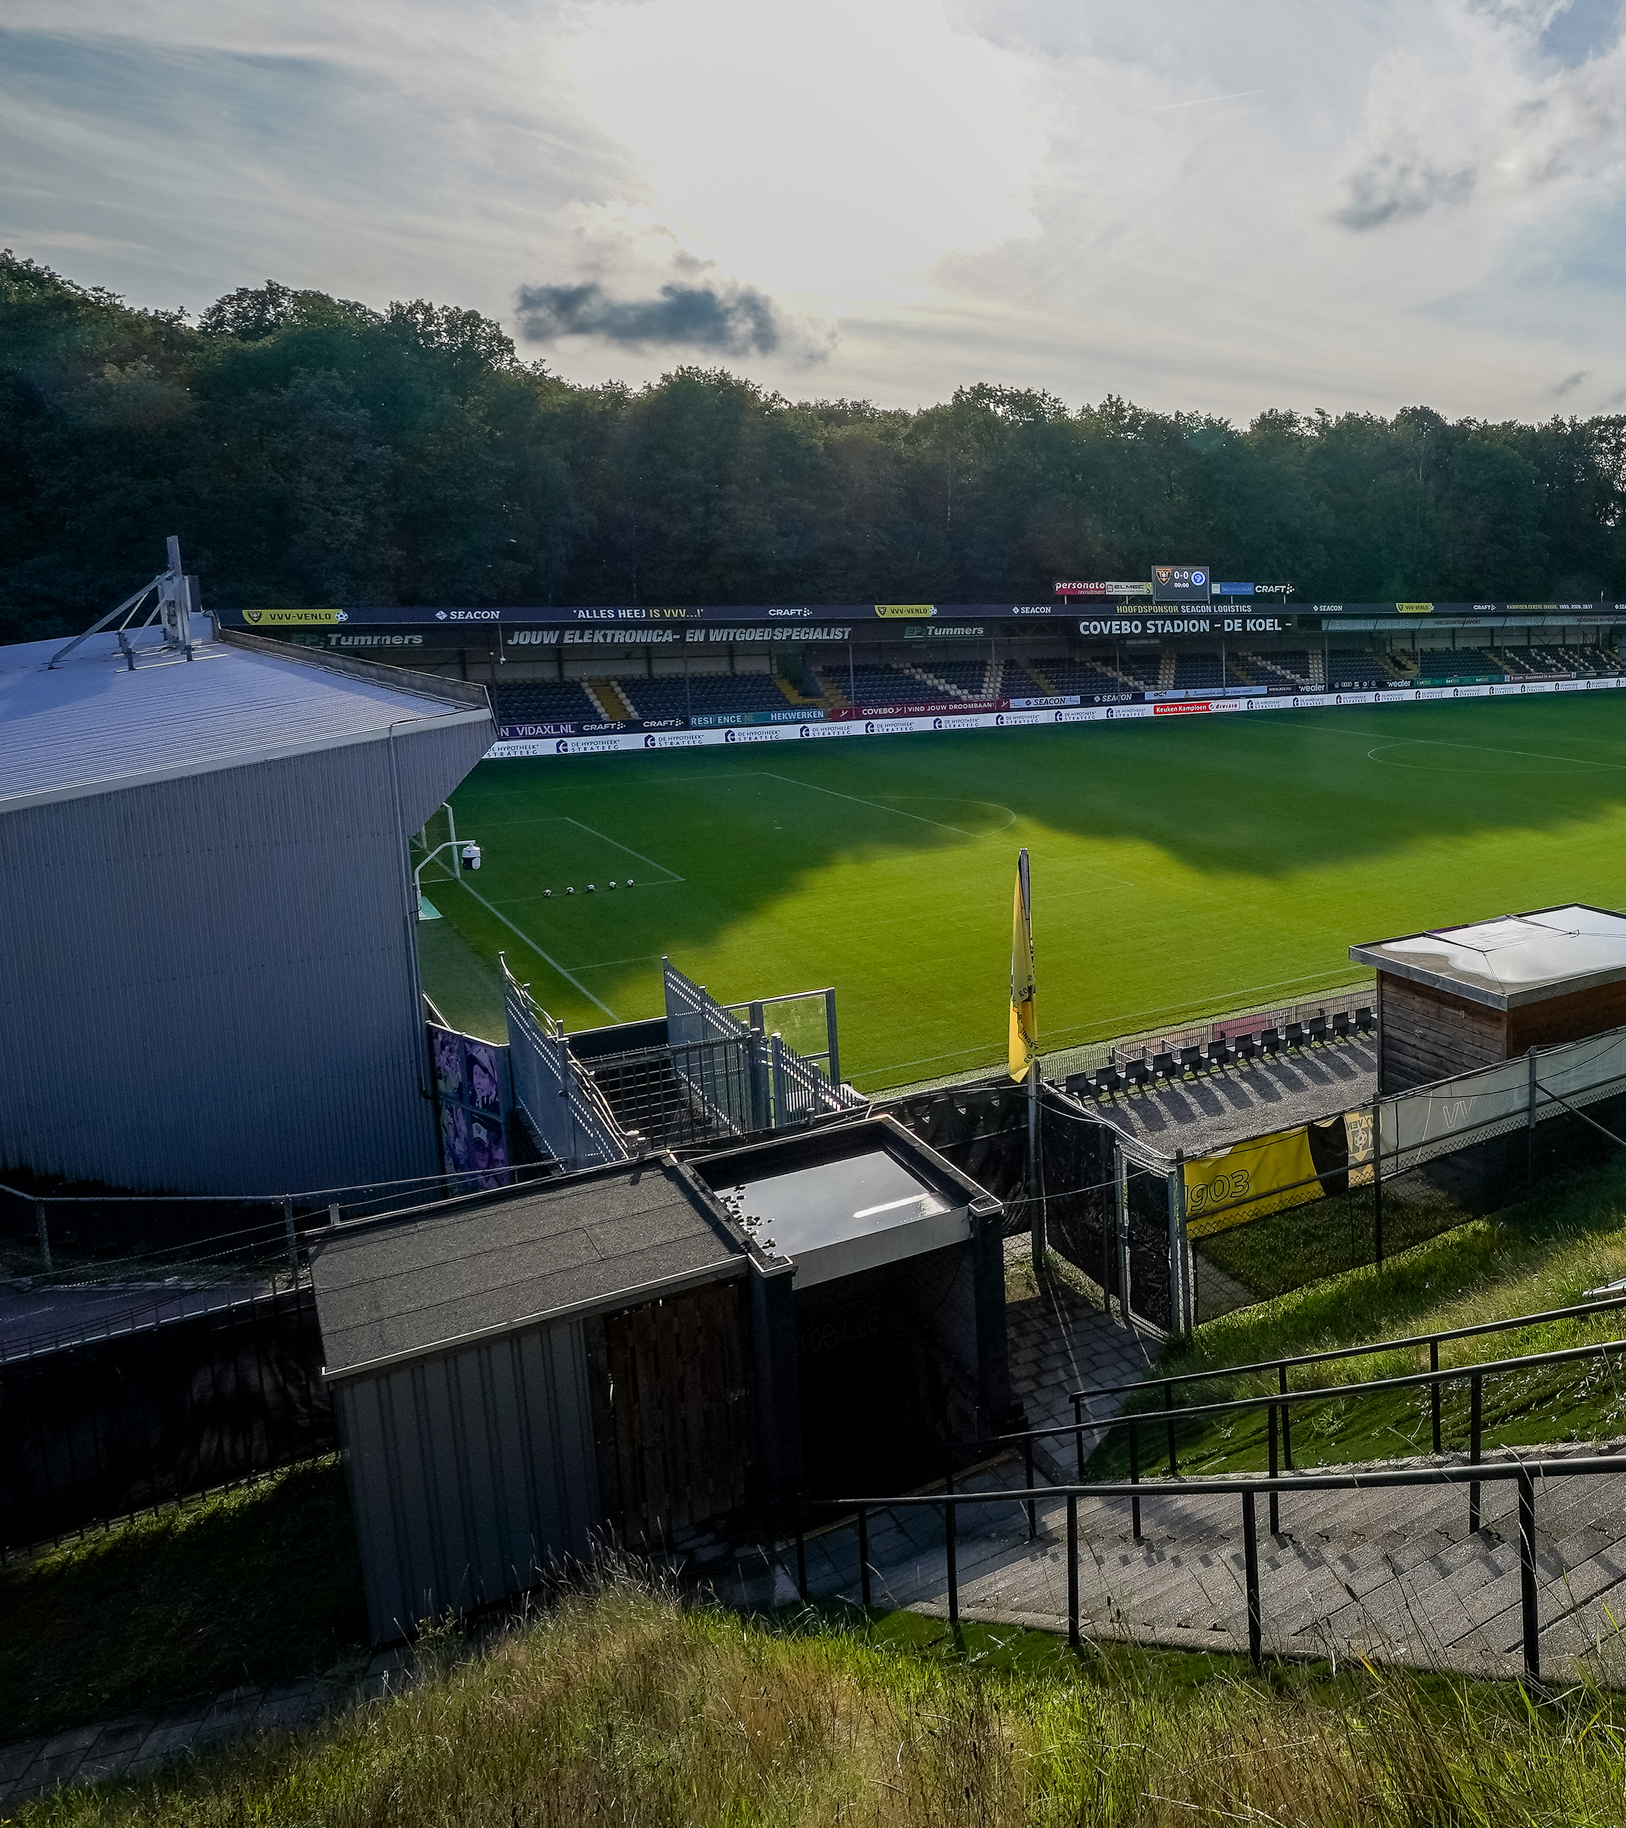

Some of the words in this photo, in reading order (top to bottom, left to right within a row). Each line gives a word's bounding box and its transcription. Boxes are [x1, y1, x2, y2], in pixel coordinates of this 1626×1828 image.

[1174, 571, 1189, 580] 0-0
[1055, 582, 1105, 591] personato
[1255, 585, 1286, 593] CRAFT
[618, 608, 646, 619] HEEJ
[649, 609, 661, 618] IS
[768, 608, 802, 617] CRAFT
[890, 607, 928, 615] VVV-VENLO
[1020, 606, 1051, 614] SEACON
[1116, 605, 1179, 613] HOOFDSPONSOR
[1181, 605, 1212, 613] SEACON
[269, 612, 332, 621] VVV-VENLO
[449, 610, 500, 620] SEACON
[926, 625, 984, 636] Tummers
[1079, 619, 1142, 635] COVEBO
[1146, 619, 1210, 633] STADION
[1224, 619, 1243, 632] DE
[1246, 619, 1282, 632] KOEL
[326, 633, 423, 646] Tummers
[507, 631, 560, 645] JOUW
[563, 629, 680, 644] ELEKTRONICA-
[685, 629, 705, 642] EN
[1299, 683, 1325, 692] wealer
[1034, 698, 1067, 706] SEACON
[1102, 694, 1132, 702] SEACON
[862, 707, 895, 716] COVEBO
[927, 704, 946, 712] JOUW
[1178, 704, 1207, 712] Kampioen
[770, 710, 824, 720] HEKWERKEN
[582, 722, 617, 731] CRAFT
[642, 720, 675, 728] CRAFT
[516, 724, 576, 736] VIDAXL.NL
[1184, 1169, 1250, 1213] 1903
